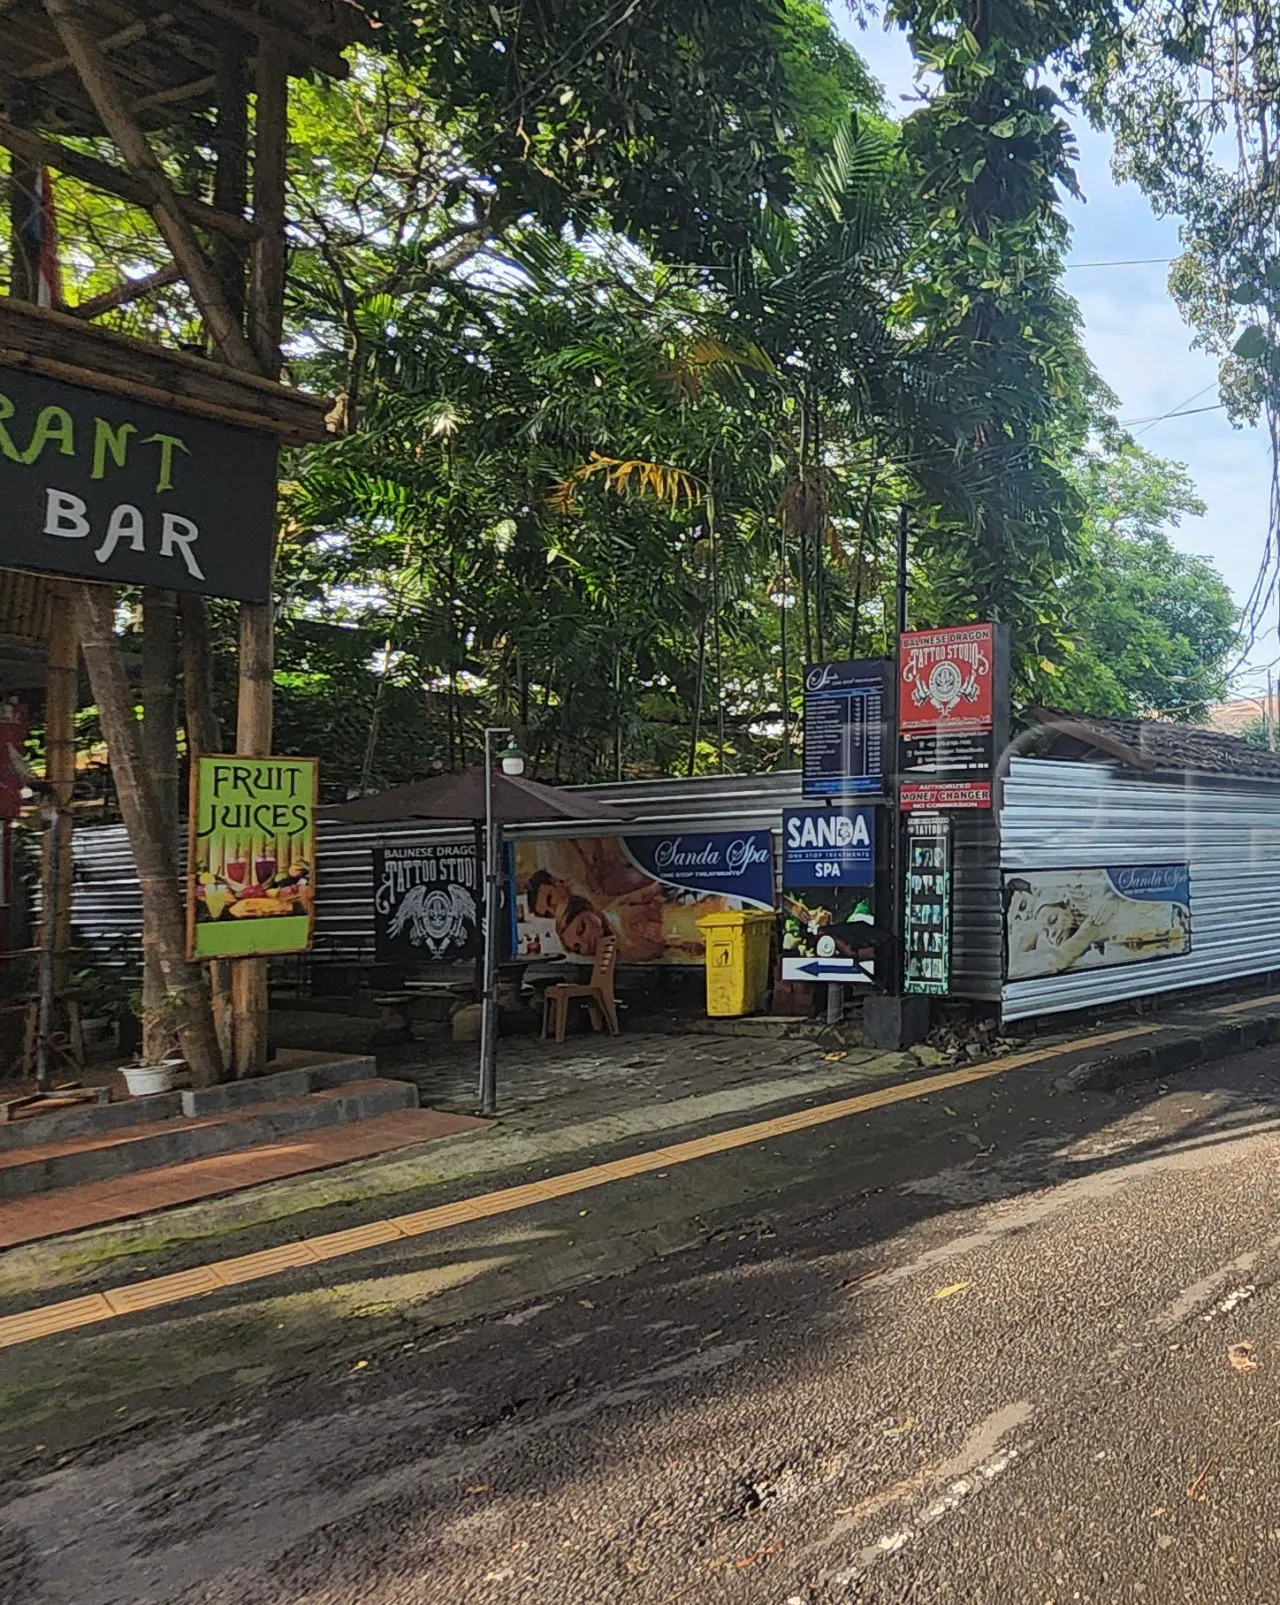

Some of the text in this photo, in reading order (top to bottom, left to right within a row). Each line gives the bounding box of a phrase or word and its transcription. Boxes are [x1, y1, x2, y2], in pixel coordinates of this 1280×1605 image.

[43, 488, 206, 582] BAR
[903, 629, 990, 649] BALINESE DRAGON
[903, 646, 946, 682] TATTOO
[946, 643, 989, 676] STUDIO
[212, 766, 302, 799] FRUIT
[901, 789, 990, 802] MONEY CHANGER
[197, 804, 308, 838] JUICES
[787, 815, 870, 848] SANDA
[384, 845, 477, 858] BALINESE DRAGO
[654, 835, 770, 875] Sanda Spa
[814, 862, 841, 878] SPA
[1118, 869, 1162, 889] Sanda
